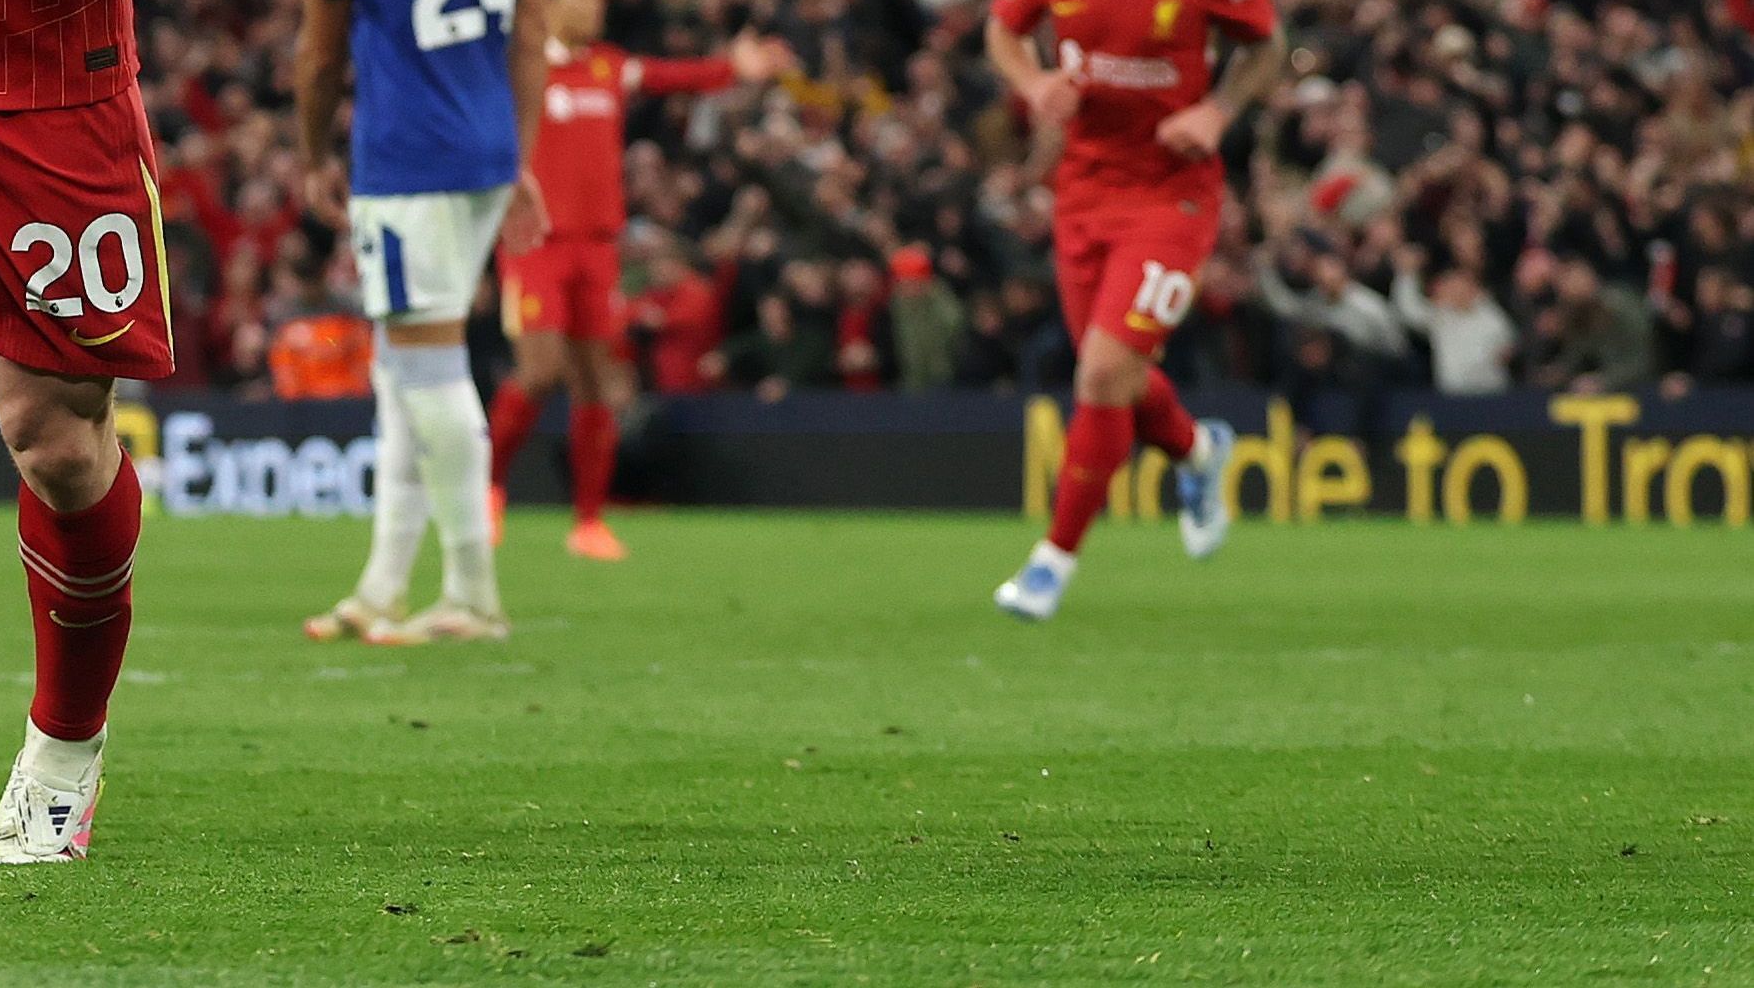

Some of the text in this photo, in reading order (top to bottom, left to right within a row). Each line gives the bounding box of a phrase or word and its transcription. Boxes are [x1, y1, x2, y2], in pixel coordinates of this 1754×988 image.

[10, 212, 145, 319] 20
[1132, 259, 1194, 327] 10
[1388, 414, 1528, 525] to
[1549, 395, 1754, 527] Tra
